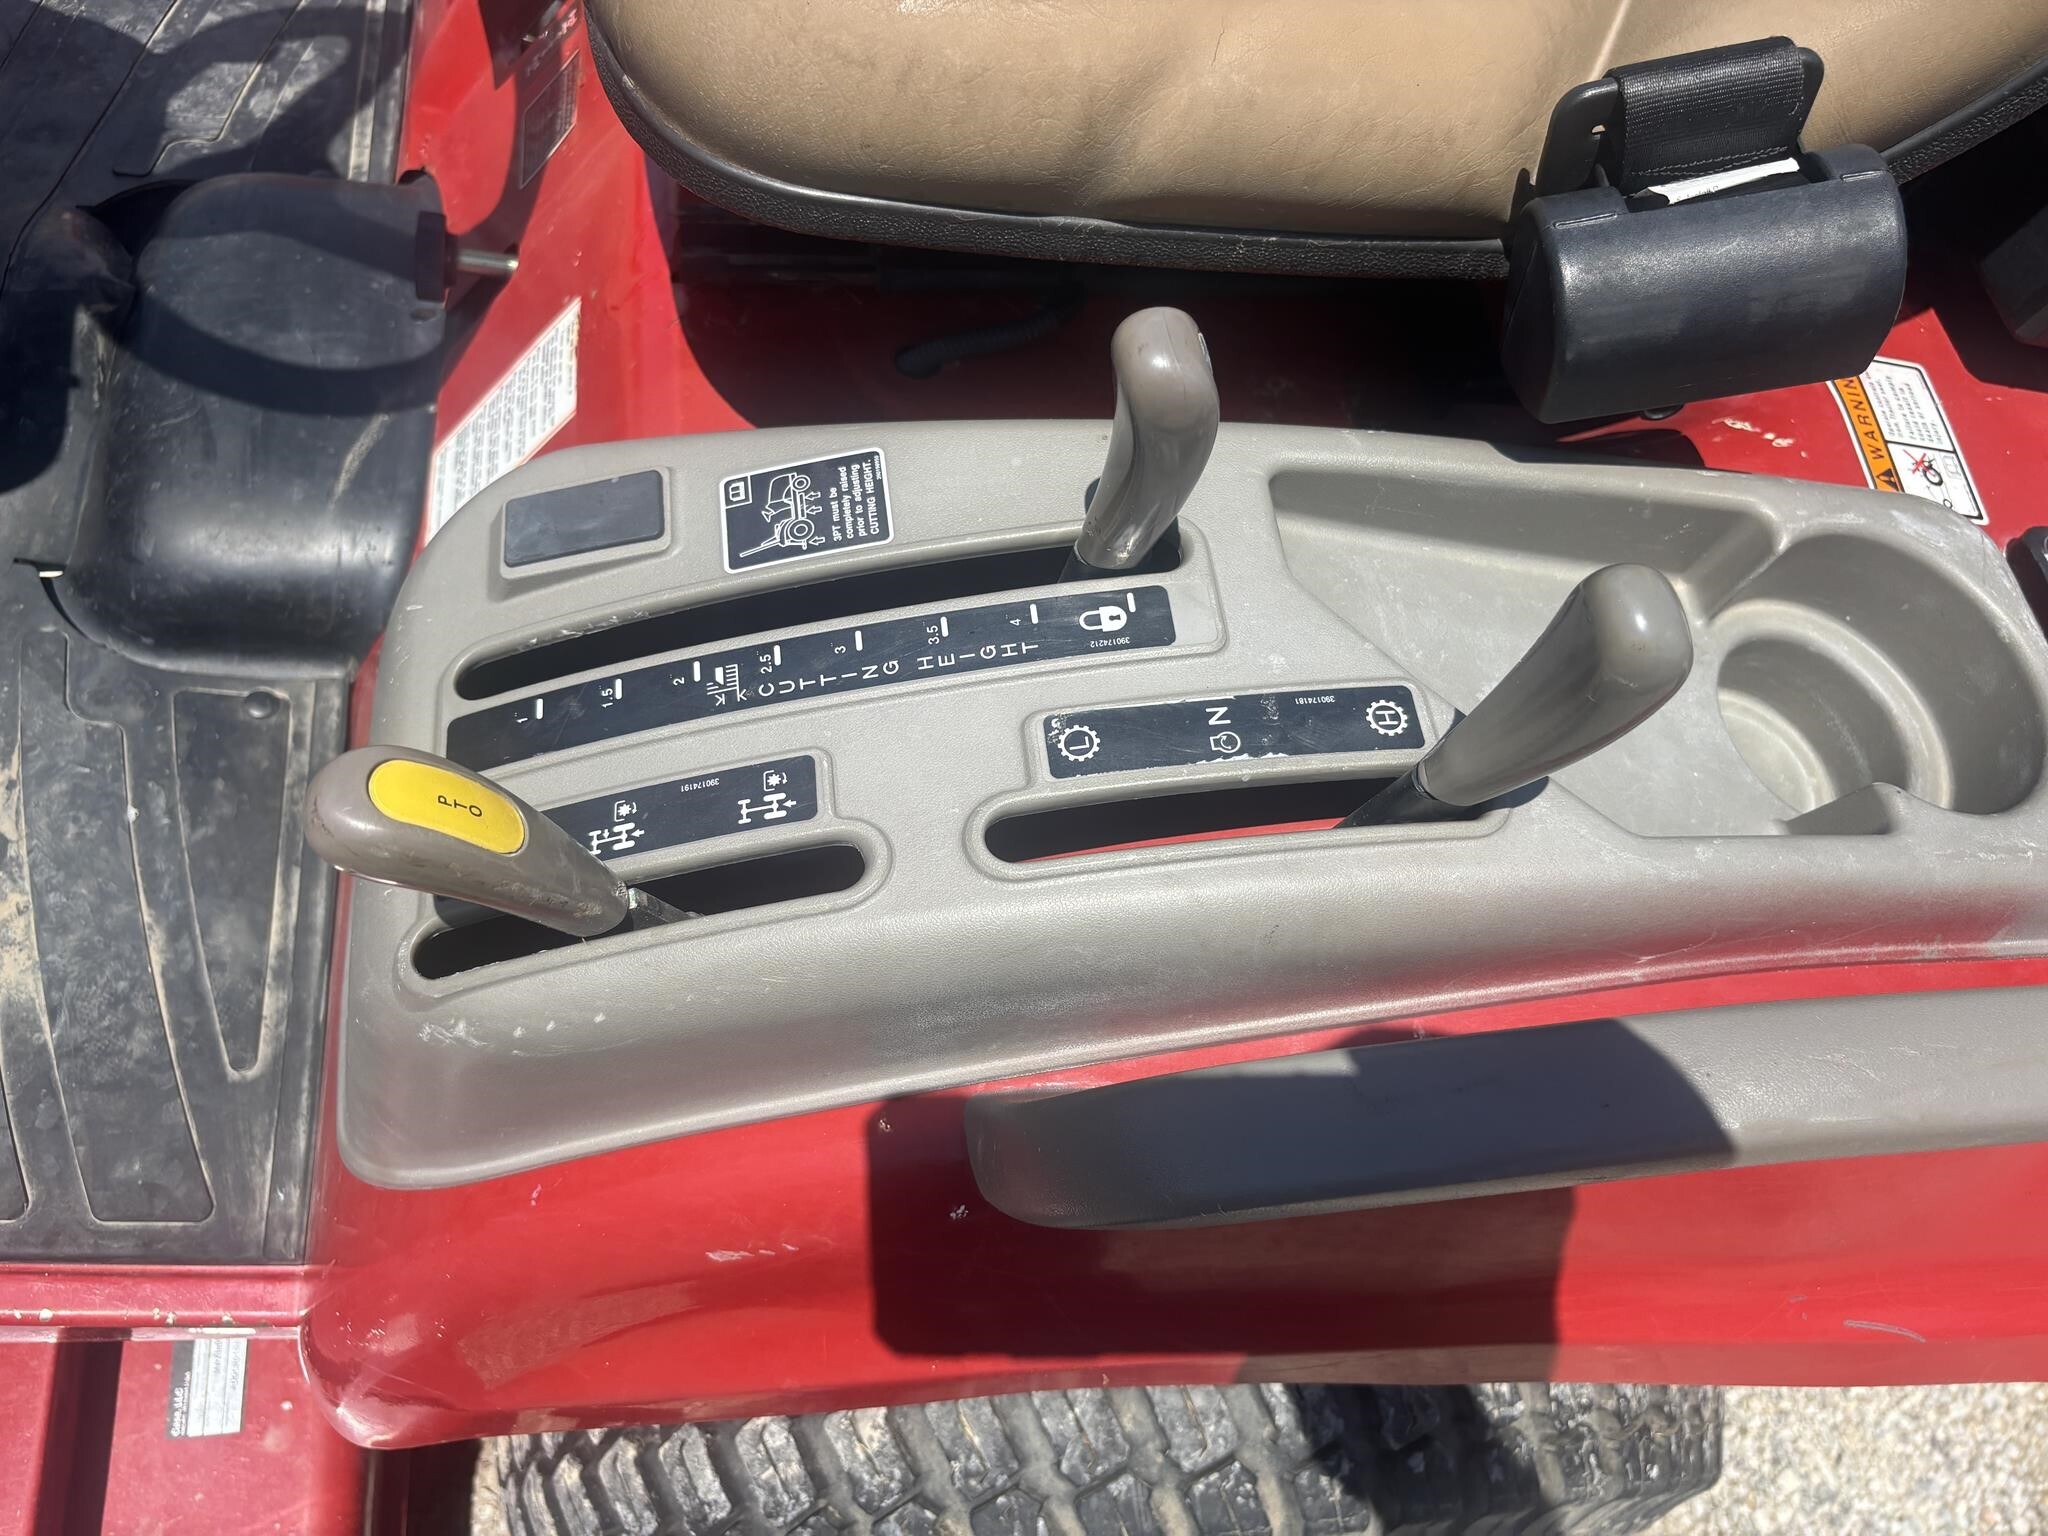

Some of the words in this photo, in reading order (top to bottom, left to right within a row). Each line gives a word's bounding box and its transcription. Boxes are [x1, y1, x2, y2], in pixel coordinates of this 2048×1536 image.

[1843, 379, 1885, 460] WARNIN
[838, 466, 847, 491] raised
[851, 464, 862, 502] adjusting
[863, 459, 874, 494] HEIGHT.
[829, 487, 838, 498] be
[832, 501, 841, 522] must
[842, 495, 854, 539] completely
[855, 505, 863, 514] to
[867, 497, 880, 535] CUTTING
[833, 526, 842, 542] 3PT
[854, 518, 868, 537] prior
[1090, 636, 1130, 648] 390174212
[758, 660, 900, 697] CUTTING
[916, 641, 1039, 670] HEIGHT
[1205, 706, 1232, 726] N
[1376, 710, 1399, 726] H
[1069, 736, 1090, 751] L
[680, 777, 720, 792] 390174191
[438, 795, 482, 818] PTO
